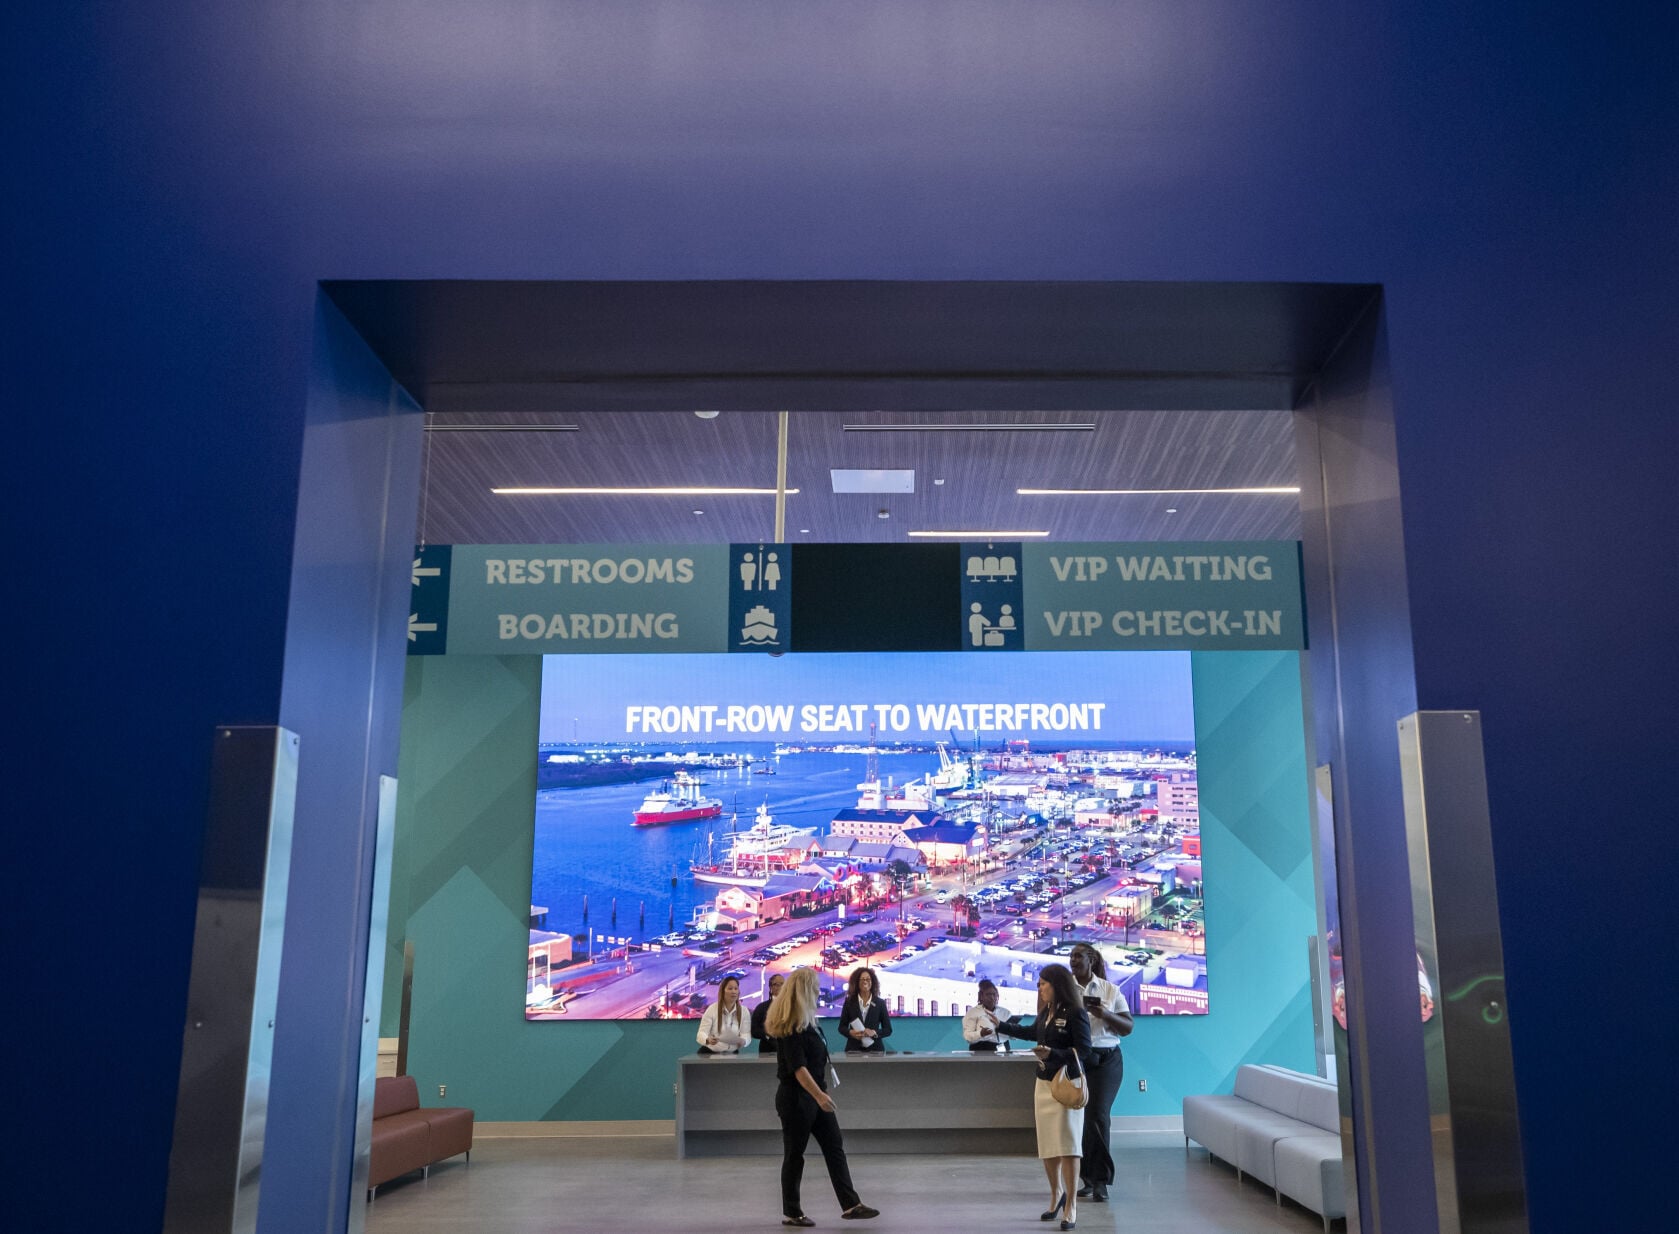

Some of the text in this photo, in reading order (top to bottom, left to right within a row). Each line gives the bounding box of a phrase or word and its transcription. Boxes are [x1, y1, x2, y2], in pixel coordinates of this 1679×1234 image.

[485, 558, 695, 585] RESTROOMS
[1049, 555, 1272, 582] VIP WAITING
[498, 612, 680, 640] BOARDING
[1043, 610, 1282, 637] VIP CHECK-IN
[625, 703, 1106, 734] FRONT-ROW SEAT TO WATERFRONT
